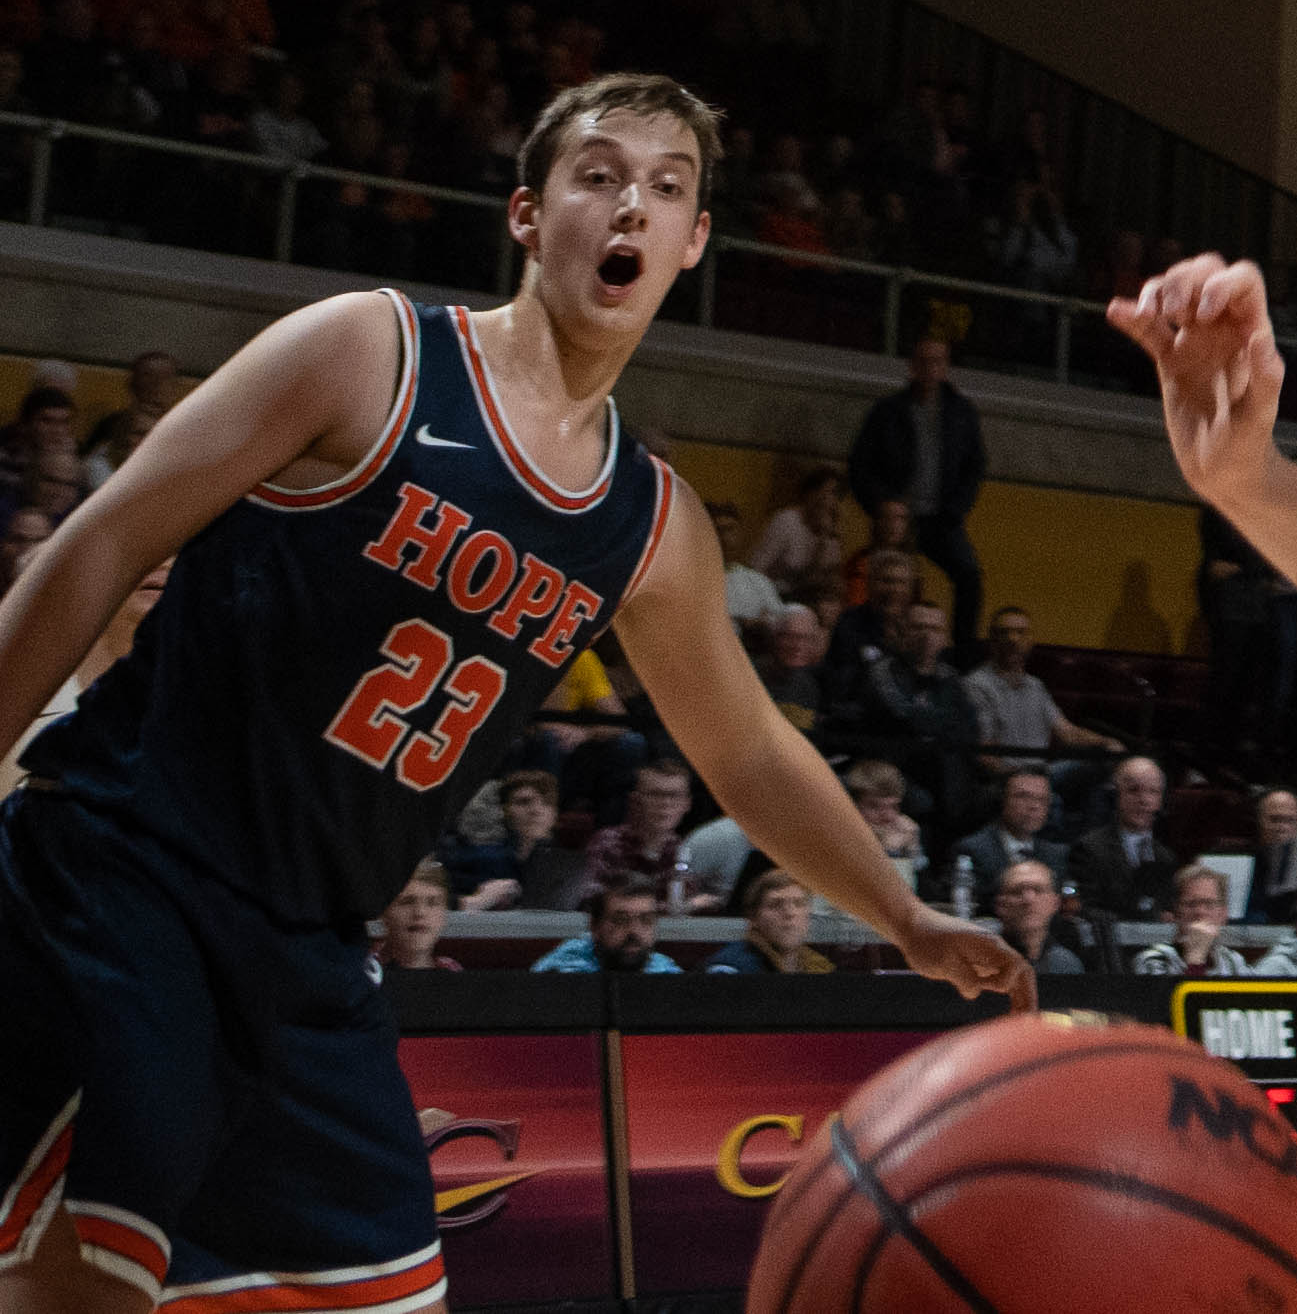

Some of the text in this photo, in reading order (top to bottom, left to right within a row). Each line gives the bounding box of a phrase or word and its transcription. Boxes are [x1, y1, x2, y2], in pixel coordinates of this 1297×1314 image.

[362, 481, 604, 670] HOPE
[321, 617, 508, 792] 23
[1200, 1009, 1296, 1059] HOME
